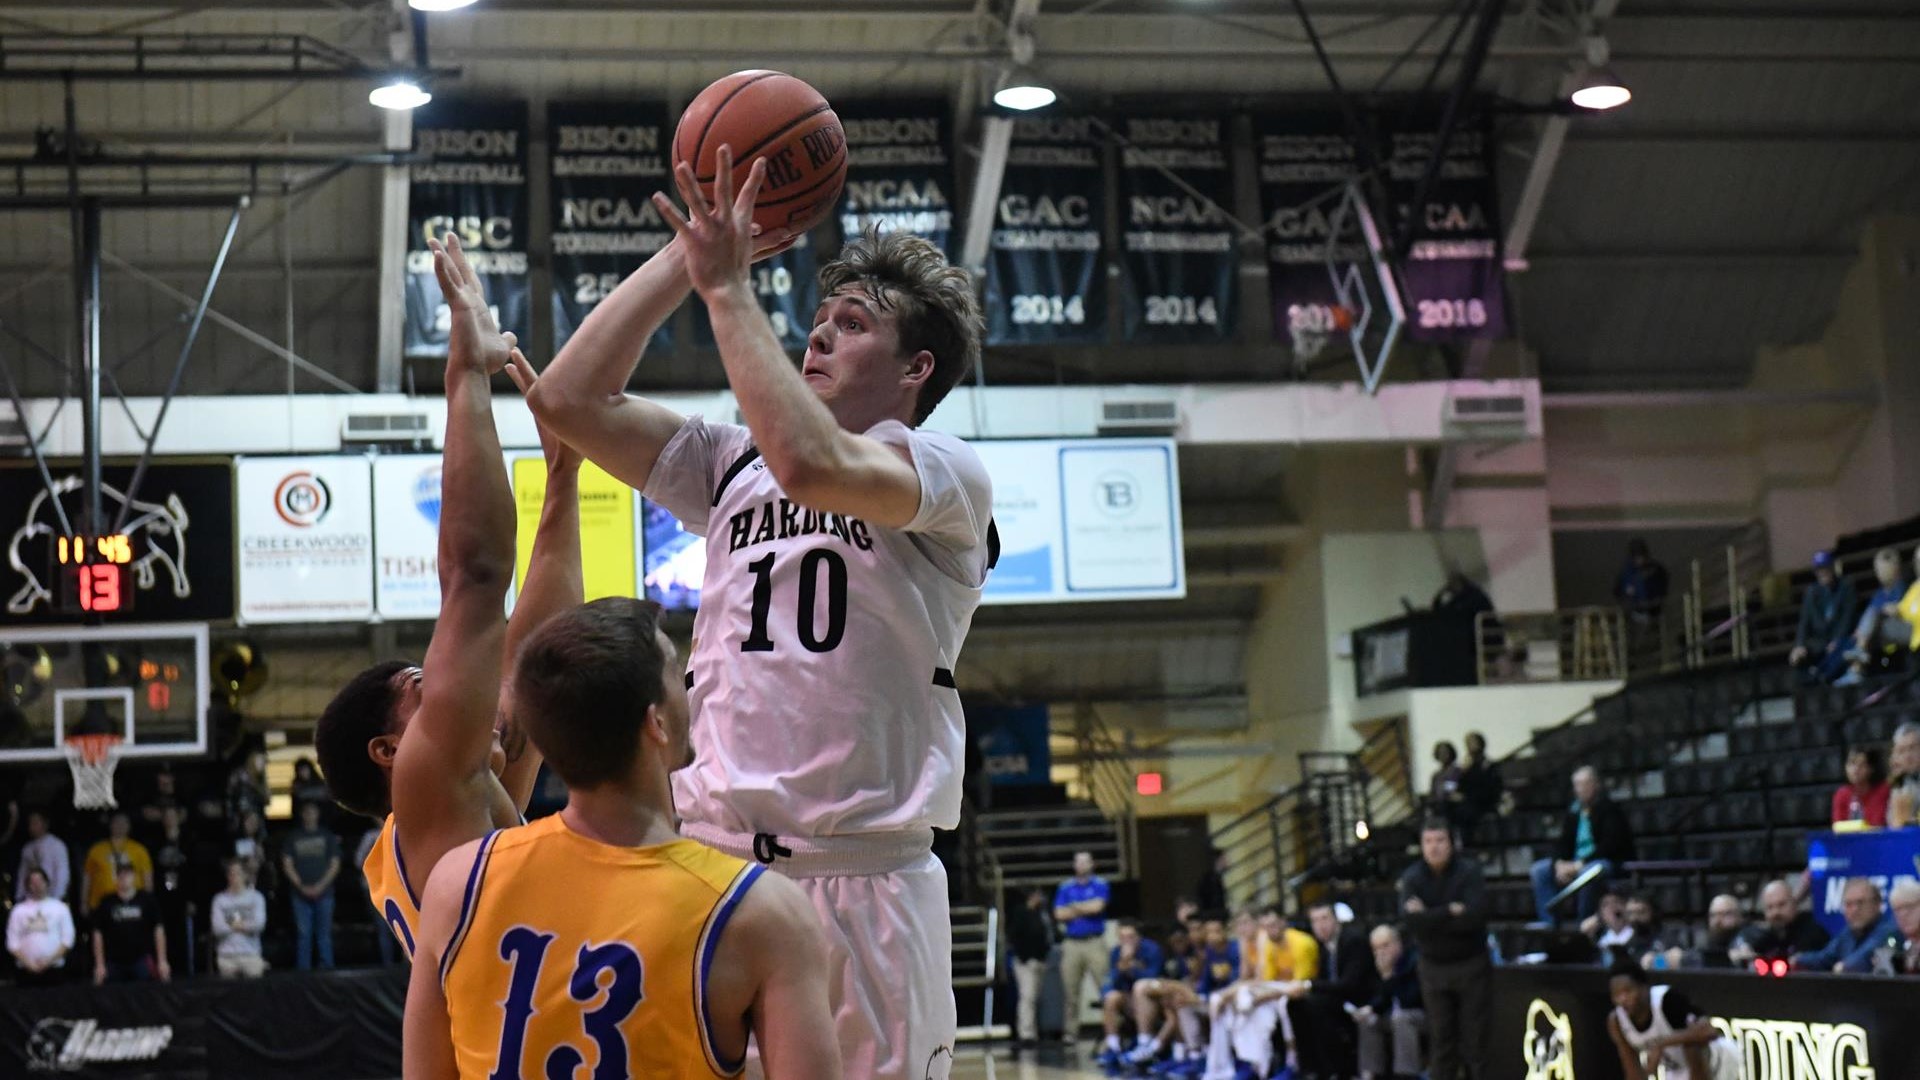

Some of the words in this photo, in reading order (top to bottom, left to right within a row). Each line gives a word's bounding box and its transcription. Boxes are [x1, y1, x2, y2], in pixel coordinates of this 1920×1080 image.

[418, 131, 518, 155] BISON
[559, 126, 658, 150] BISON
[1126, 119, 1221, 143] BISON
[846, 180, 947, 210] NCAA
[999, 194, 1090, 225] GAC
[562, 199, 661, 226] NCAA
[1131, 196, 1226, 225] NCAA
[1011, 295, 1086, 325] 2014
[1146, 295, 1218, 325] 2014
[729, 498, 875, 554] HARDING
[79, 564, 120, 612] 13
[740, 548, 848, 653] 10
[489, 925, 644, 1080] 13
